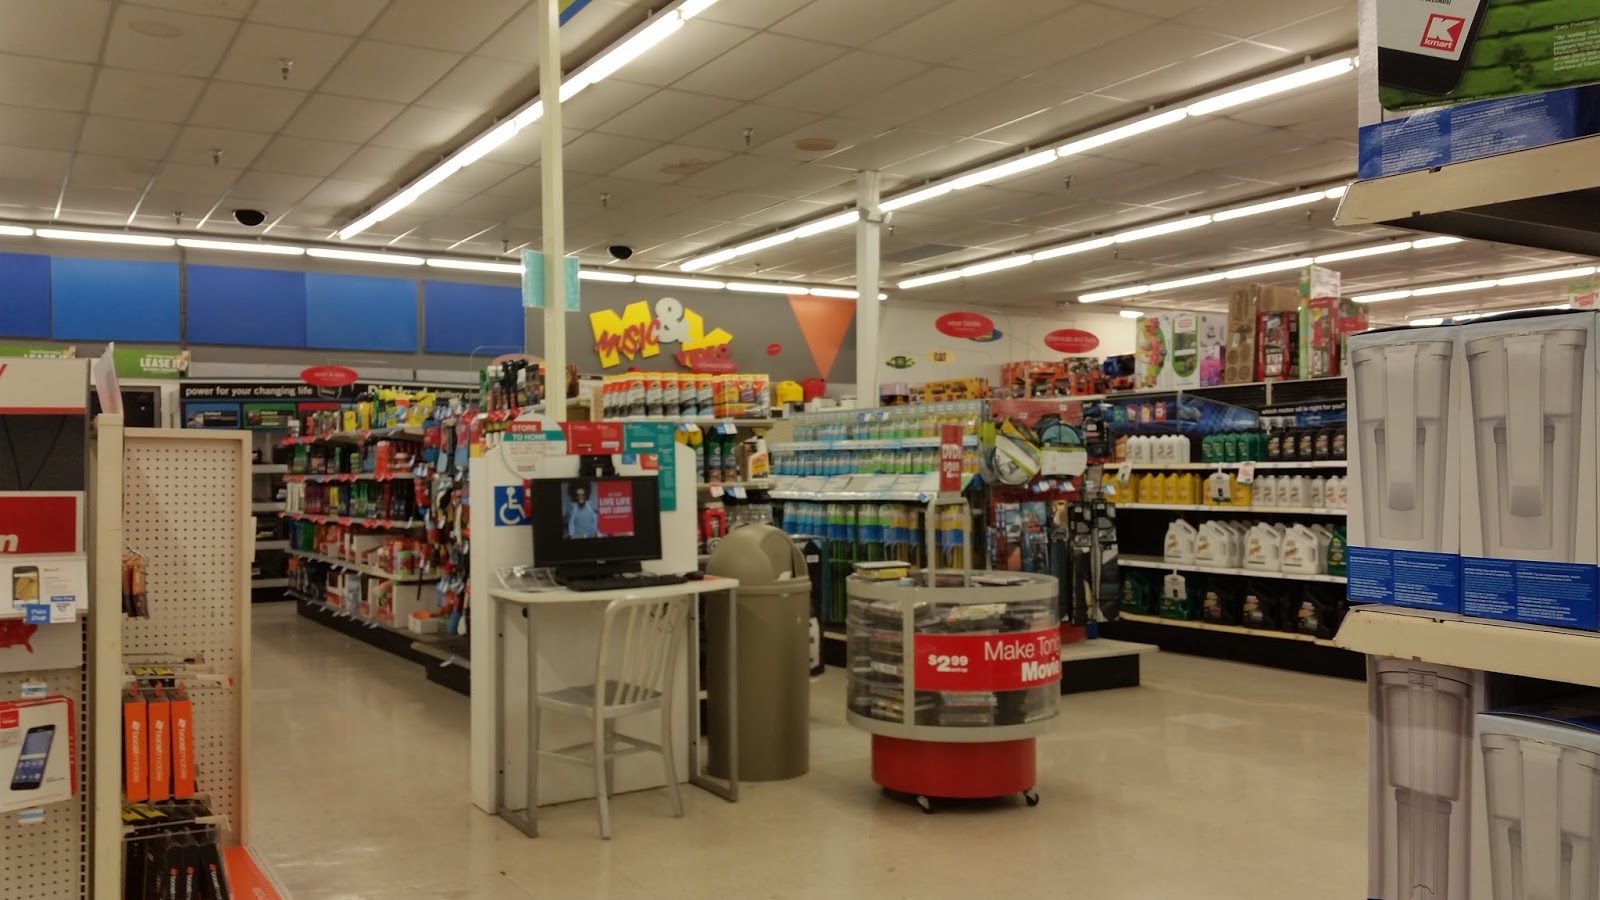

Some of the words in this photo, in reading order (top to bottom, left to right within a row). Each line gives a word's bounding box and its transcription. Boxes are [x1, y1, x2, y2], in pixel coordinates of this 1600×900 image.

[1424, 38, 1453, 49] kmart
[140, 357, 171, 368] LEASE
[185, 387, 214, 397] power
[216, 386, 229, 395] for
[231, 387, 252, 397] your
[253, 386, 296, 397] changing
[297, 386, 313, 396] life
[1332, 402, 1346, 410] you?
[511, 424, 537, 432] STORE
[984, 640, 1036, 661] Make
